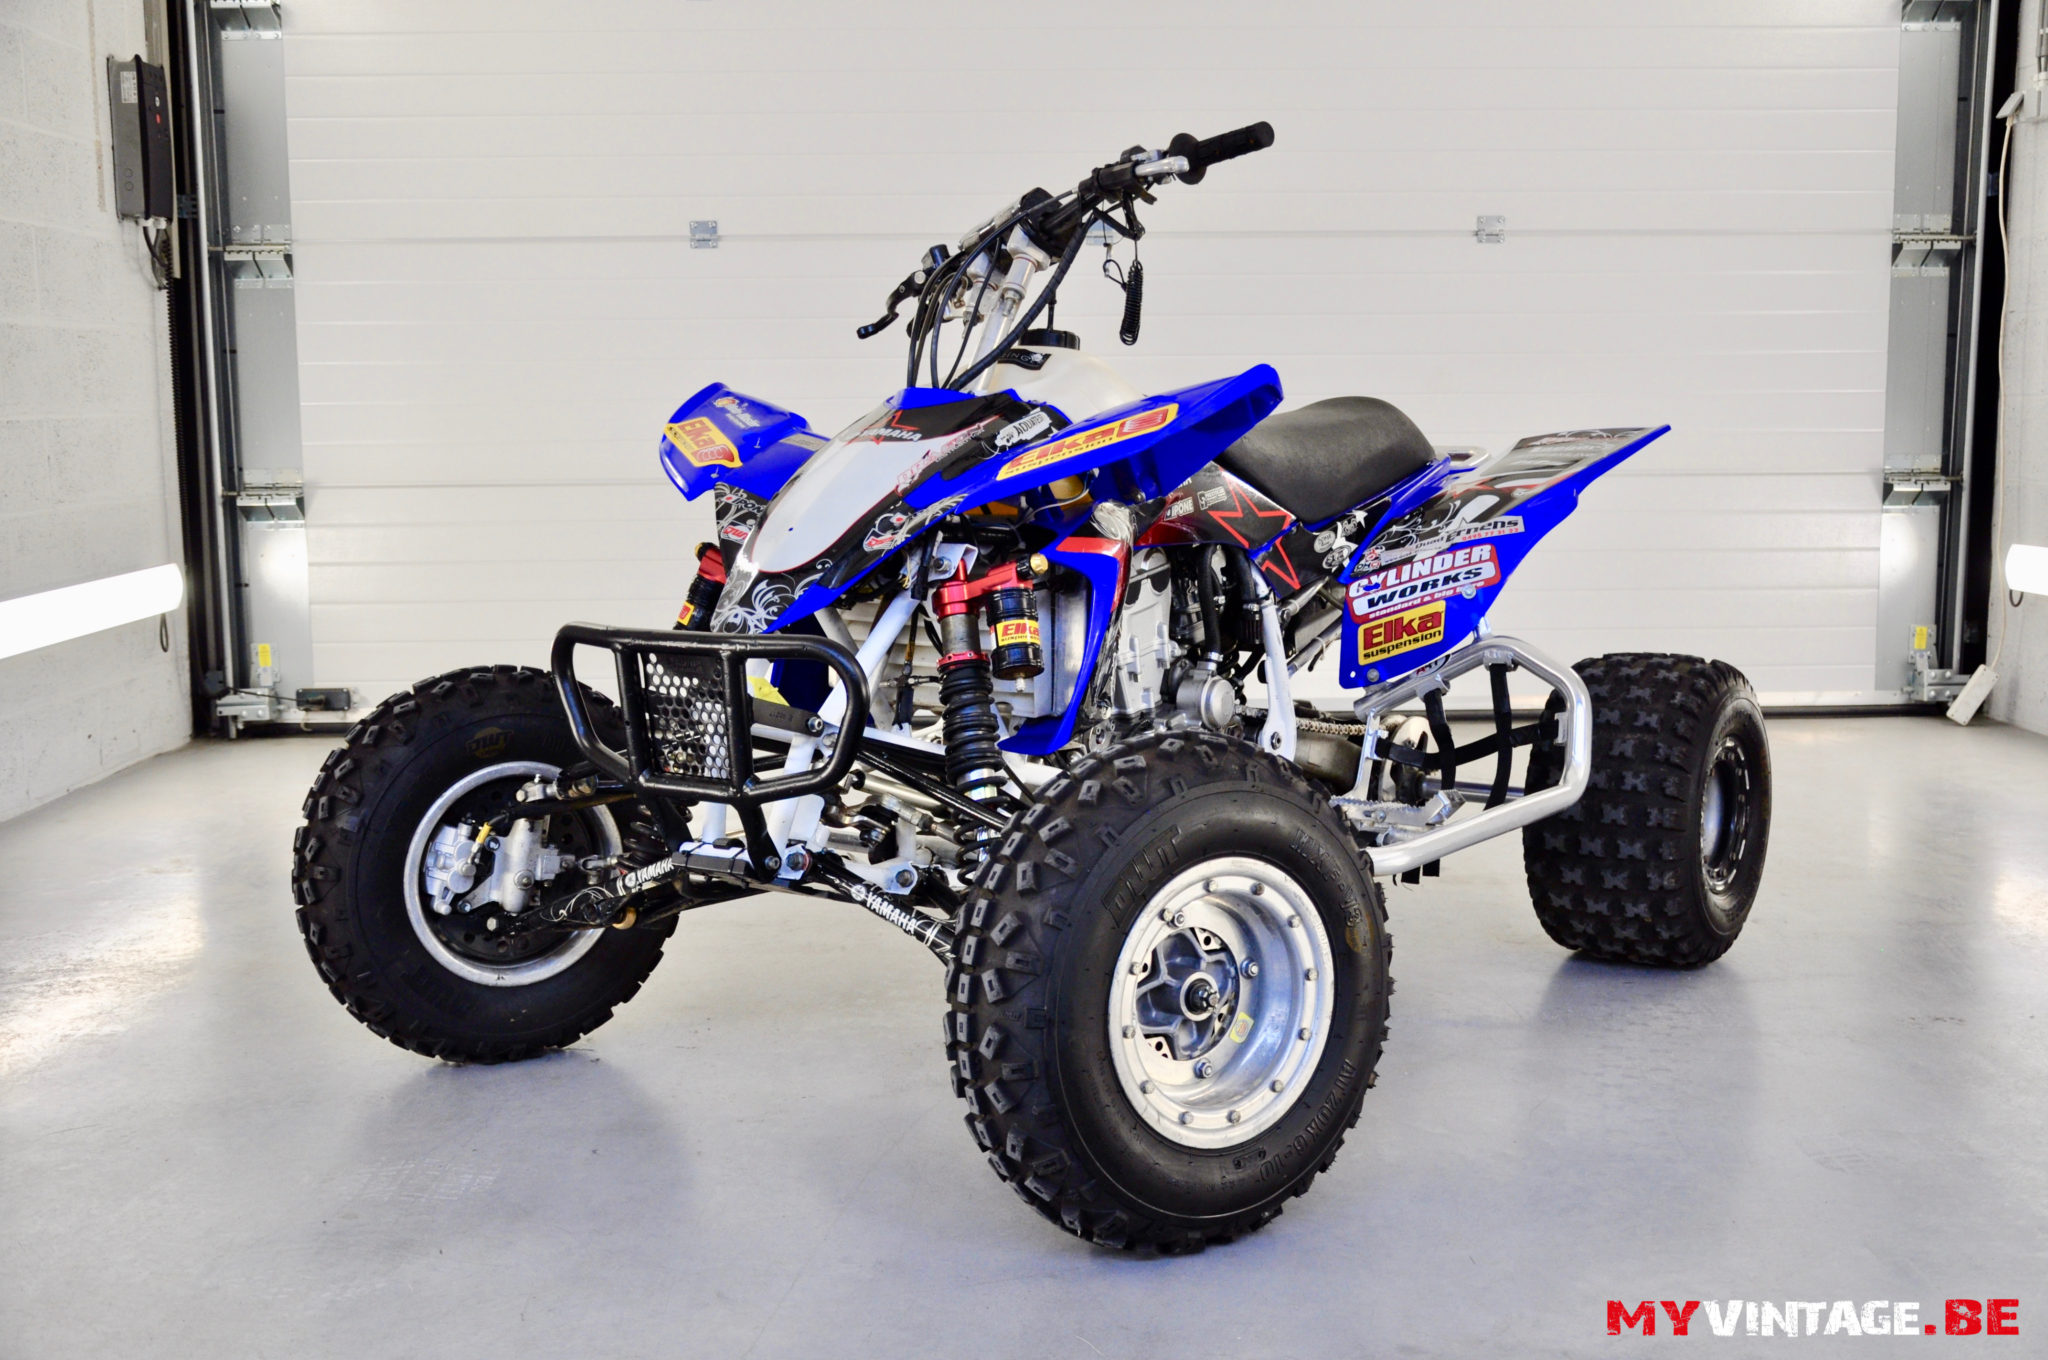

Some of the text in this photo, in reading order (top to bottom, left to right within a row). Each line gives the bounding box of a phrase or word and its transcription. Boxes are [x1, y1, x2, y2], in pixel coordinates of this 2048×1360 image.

[1006, 427, 1115, 470] Elka
[1349, 544, 1492, 598] CYLINDER
[1367, 567, 1483, 609] WORKS
[1368, 597, 1421, 619] standard
[1434, 588, 1455, 601] big
[1363, 611, 1443, 651] Elka
[1363, 629, 1442, 660] suspension
[637, 857, 674, 884] YAMAHA
[866, 892, 917, 935] YAMAHA
